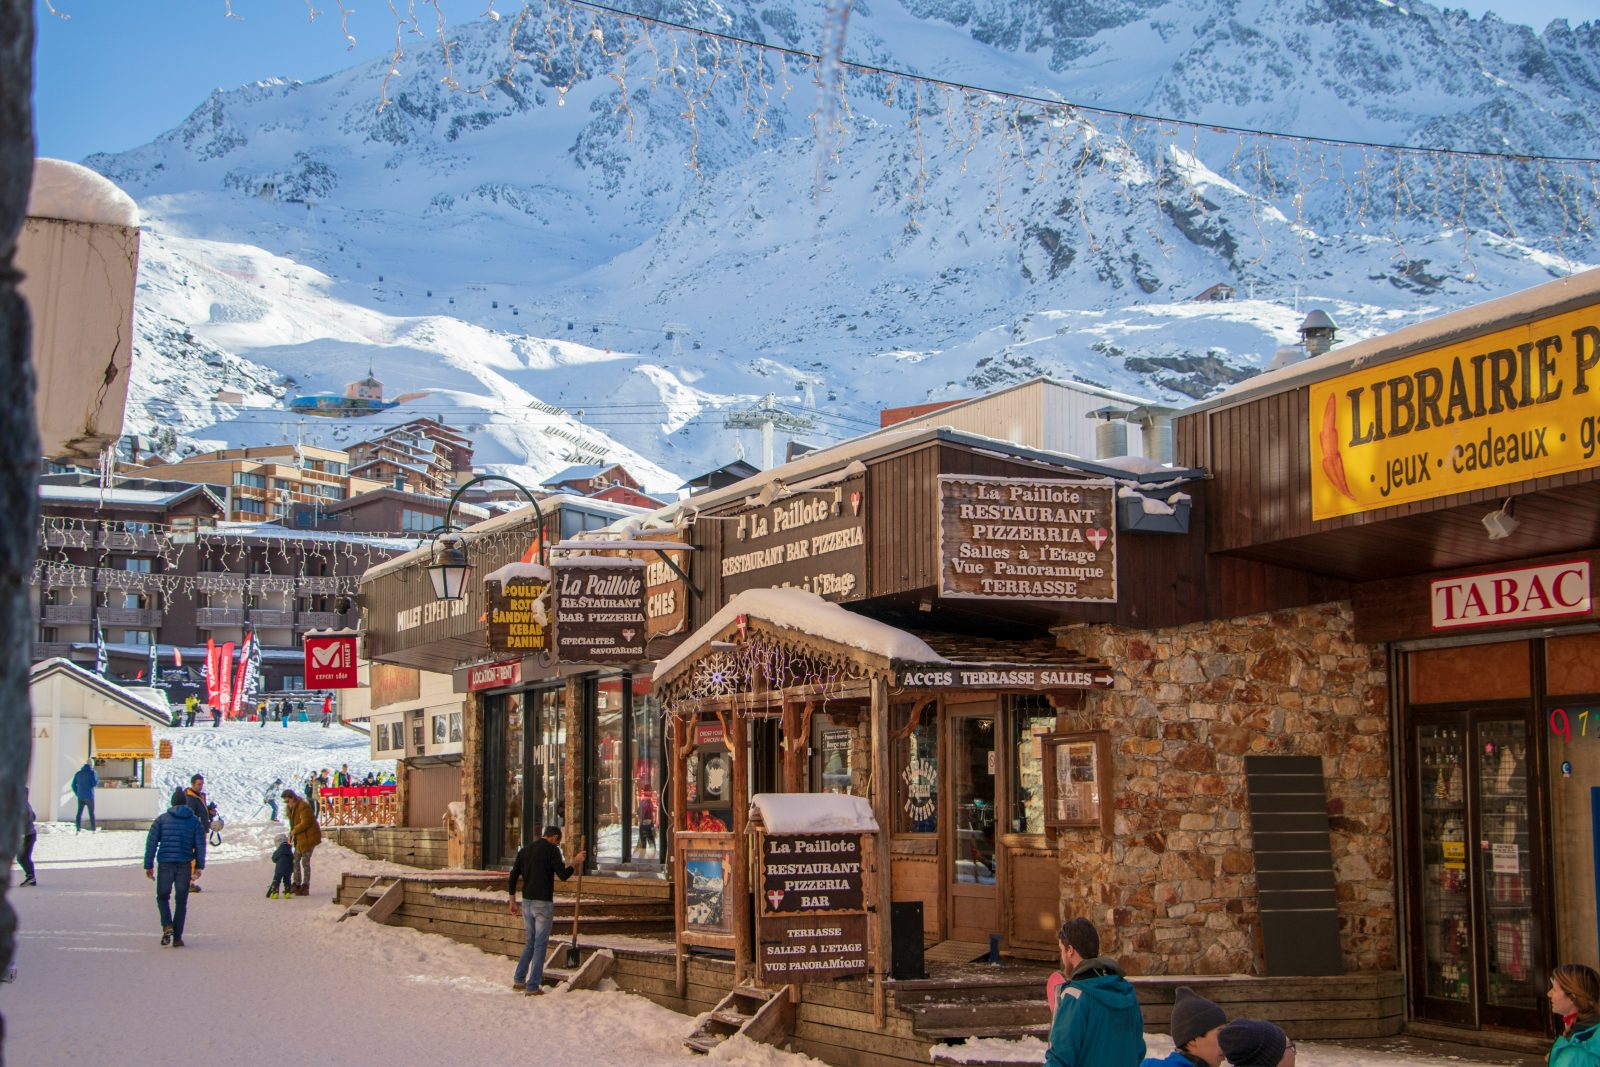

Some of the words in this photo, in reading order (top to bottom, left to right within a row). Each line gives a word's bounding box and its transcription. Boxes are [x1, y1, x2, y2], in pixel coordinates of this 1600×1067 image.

[1347, 334, 1563, 448] LIBRAIRIE
[1380, 452, 1431, 497] jeux
[1452, 427, 1548, 474] cadeaux
[978, 486, 1000, 500] La
[1010, 486, 1080, 504] Paillote
[750, 514, 768, 539] La
[773, 498, 829, 534] Paillote
[960, 504, 1096, 524] RESTAURANT
[972, 524, 1084, 543] PIZZERRIA
[722, 545, 785, 577] RESTAURANT
[786, 540, 810, 562] BAR
[812, 526, 864, 556] PIZZERIA
[960, 543, 1010, 559] Salles
[1018, 545, 1030, 560] à
[952, 558, 984, 574] Vue
[994, 562, 1104, 580] Panoramique
[561, 574, 582, 596] La
[586, 574, 641, 596] Paillote
[981, 579, 1077, 595] TERRASSE
[1436, 569, 1584, 620] TABAC
[561, 598, 642, 608] RESTAURANT
[397, 605, 422, 632] MILLET
[424, 600, 448, 624] EXPERT
[560, 612, 584, 622] BAR
[588, 613, 645, 622] PIZZERIA
[510, 624, 542, 636] KEBAB
[507, 636, 544, 648] PANINI
[561, 637, 615, 645] SPECIALITES
[590, 646, 643, 655] SAVOYARDES
[472, 668, 496, 684] LOCATION
[500, 665, 513, 680] RENT
[904, 672, 952, 686] ACCES
[960, 671, 1034, 685] TERRASSE
[1040, 672, 1092, 686] SALLES
[770, 841, 791, 854] La
[794, 839, 856, 854] Paillote
[768, 863, 860, 875] RESTAURANT
[784, 880, 850, 892] PIZZERIA
[801, 896, 830, 908] BAR
[787, 928, 842, 938] TERRASSE
[768, 946, 806, 955] SALLES
[764, 962, 786, 972] VUE
